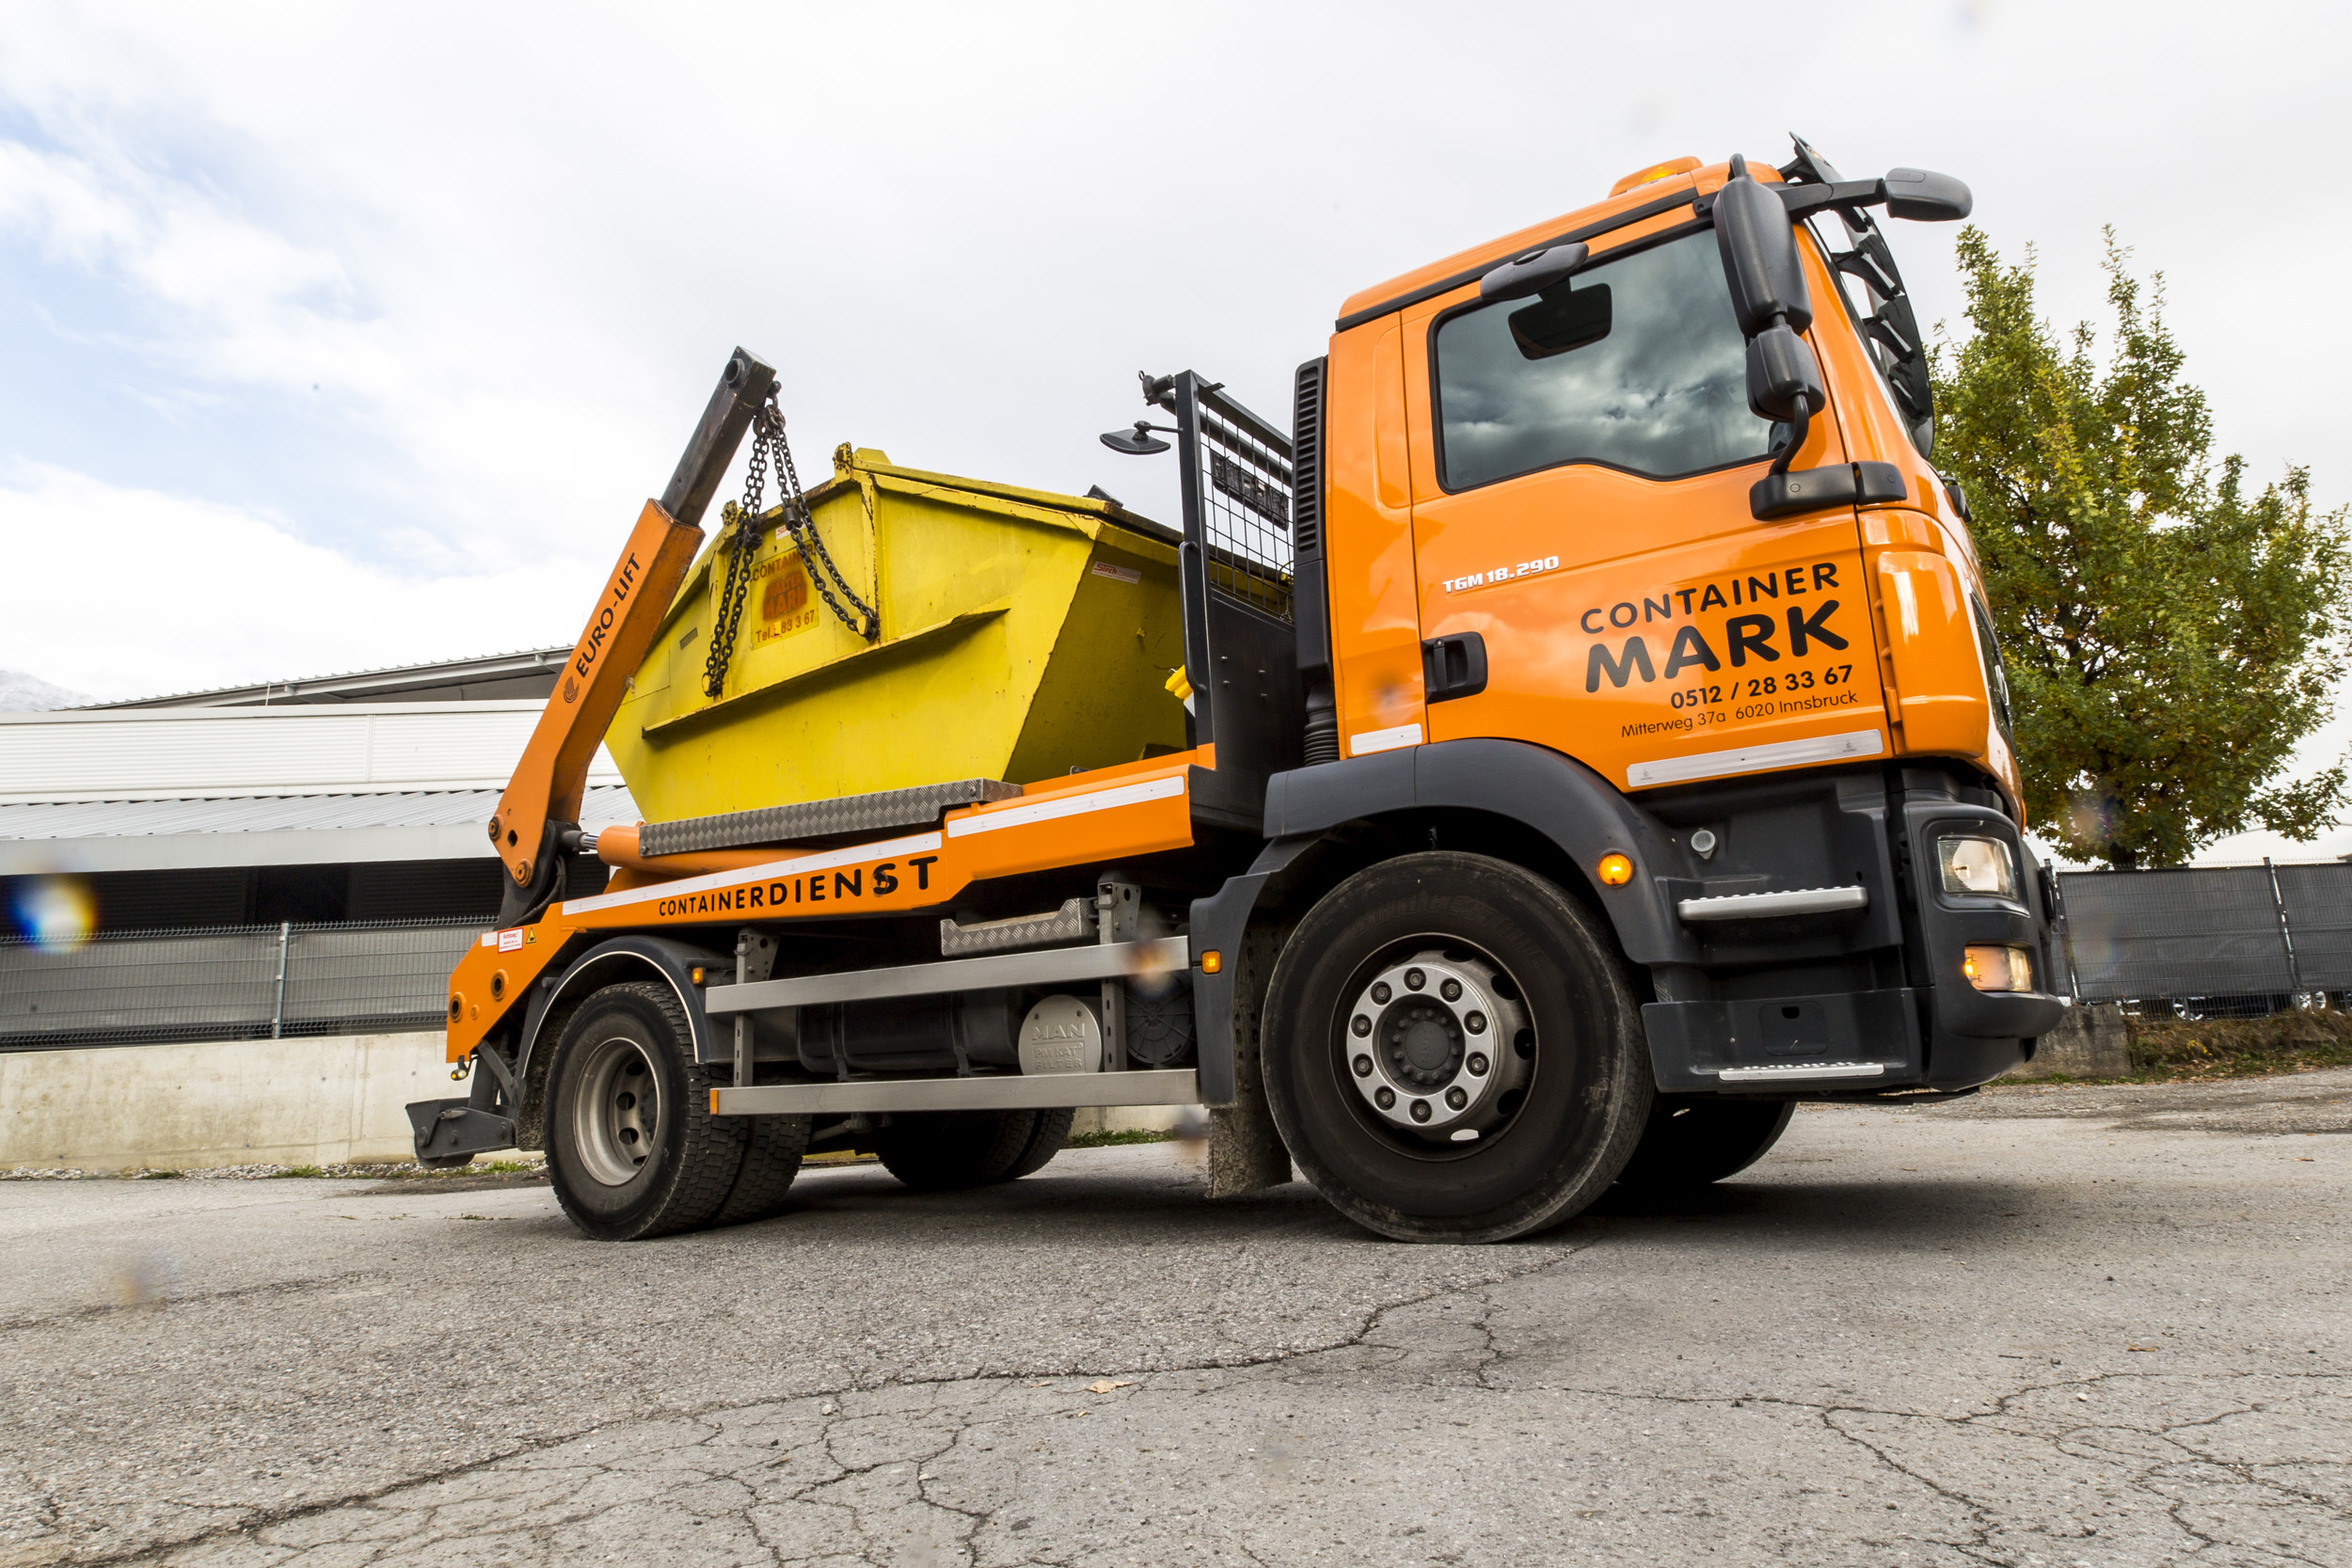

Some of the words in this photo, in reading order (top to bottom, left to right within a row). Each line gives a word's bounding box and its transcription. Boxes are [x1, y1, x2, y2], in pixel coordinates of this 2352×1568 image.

[753, 543, 816, 582] CONTAINR
[1442, 572, 1484, 593] TGM
[1486, 555, 1559, 583] 18.290
[803, 609, 815, 626] 67
[1581, 562, 1839, 634] CONTAINER
[1585, 599, 1850, 693] MARK
[1670, 685, 1723, 709] 0512
[1730, 681, 1740, 701] /
[1748, 676, 1777, 697] 28
[1785, 670, 1815, 691] 33
[1823, 664, 1853, 686] 67
[1620, 716, 1693, 738] Mitterweg
[1697, 710, 1726, 726] 37a
[1735, 702, 1774, 721] 6020
[1779, 689, 1859, 714] Innsbruck
[659, 855, 939, 917] CONTAINERDIENST
[1031, 1022, 1086, 1041] MAN
[1035, 1058, 1083, 1069] FILTER
